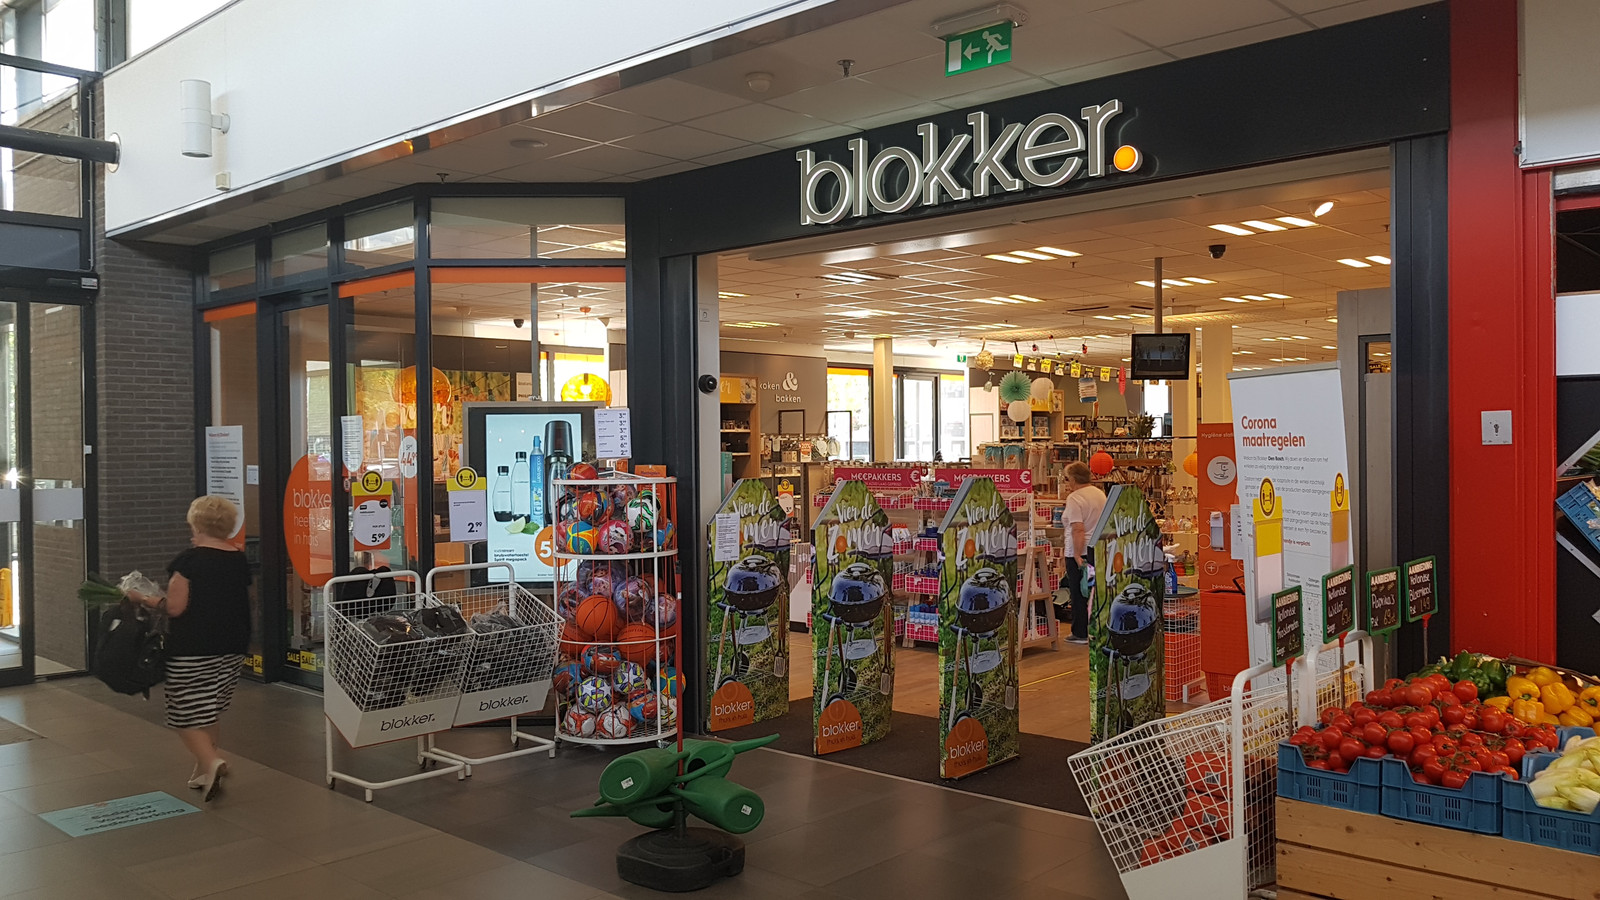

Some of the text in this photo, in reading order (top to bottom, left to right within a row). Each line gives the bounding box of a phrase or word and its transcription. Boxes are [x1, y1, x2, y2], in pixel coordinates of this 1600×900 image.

[796, 99, 1143, 226] blokker.
[775, 394, 801, 403] bakken
[1241, 415, 1277, 429] Corona
[1242, 432, 1306, 451] maatregelen
[293, 488, 332, 509] blokke
[733, 490, 771, 518] Vier de
[836, 493, 873, 523] Vier de
[965, 491, 999, 526] Vier de
[468, 522, 482, 533] 2.99
[1113, 500, 1147, 538] Vier de
[371, 533, 385, 543] 5.99
[739, 517, 778, 545] mer
[479, 694, 529, 712] blokker.
[380, 712, 436, 732] blokker.
